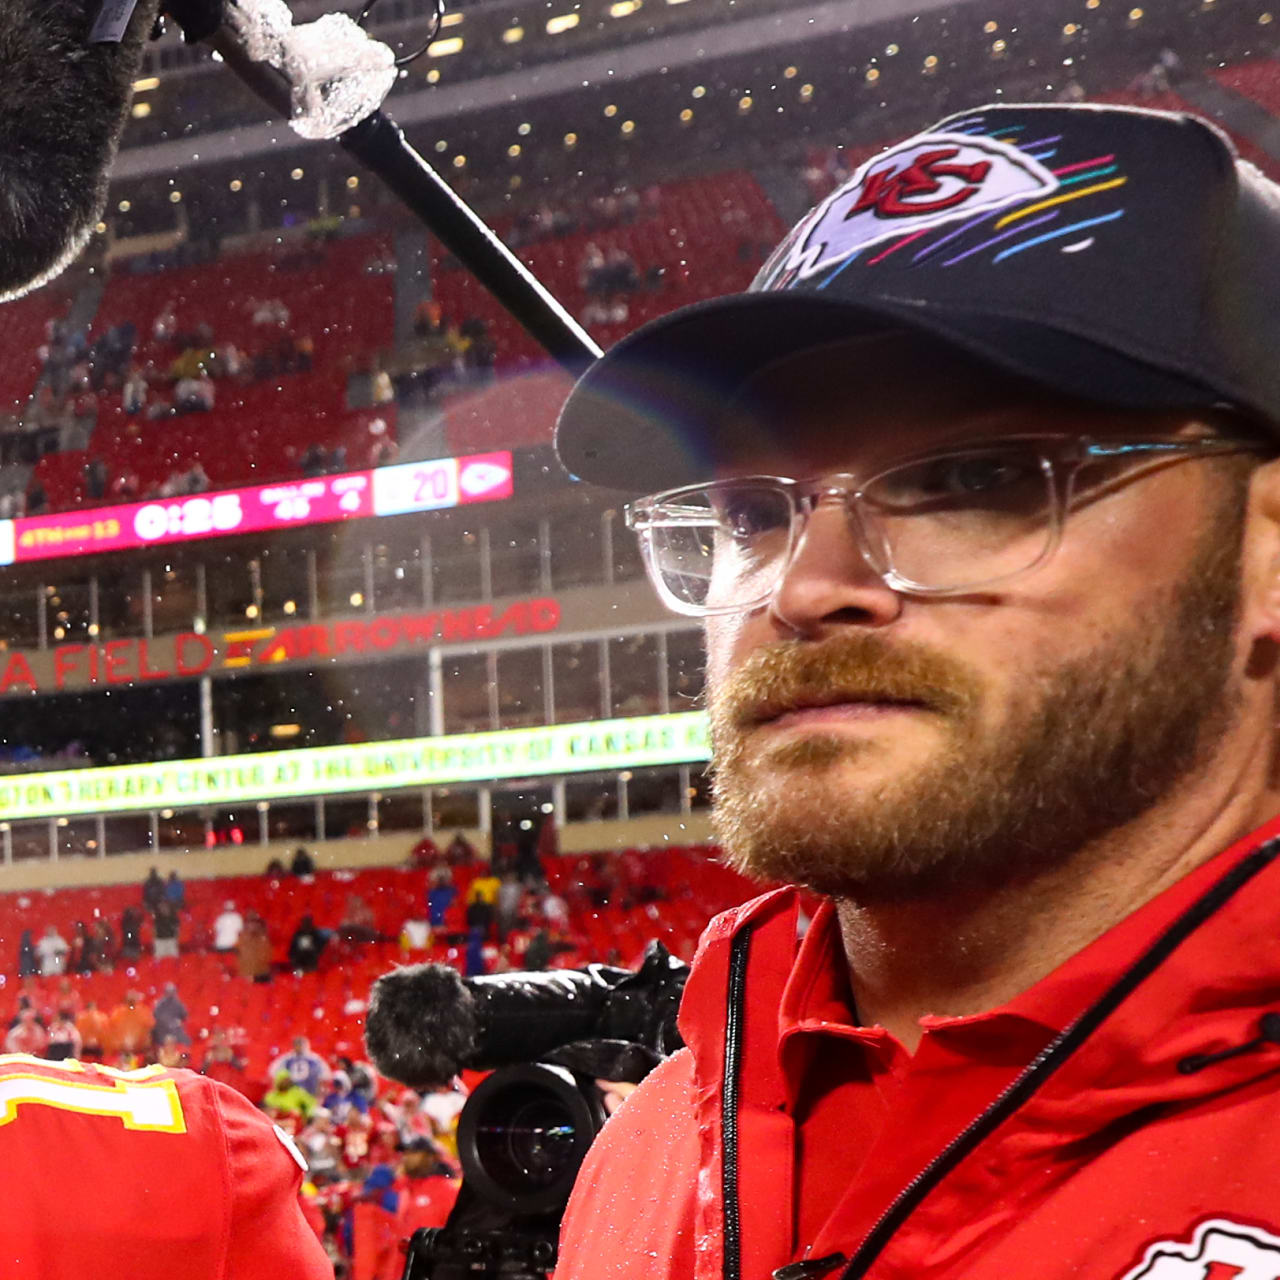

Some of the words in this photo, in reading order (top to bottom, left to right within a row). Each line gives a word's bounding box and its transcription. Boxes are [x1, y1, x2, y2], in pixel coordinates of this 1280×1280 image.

[413, 469, 449, 502] 20
[53, 632, 214, 689] FIELD
[257, 597, 561, 664] ARROWHEAD
[66, 774, 166, 803] THERAPY
[175, 763, 266, 793] CENTER
[274, 759, 302, 783] AT
[312, 757, 353, 781] THE
[365, 742, 517, 778] UNIVERSITY
[527, 737, 555, 762] OF
[568, 725, 676, 759] KANSAS
